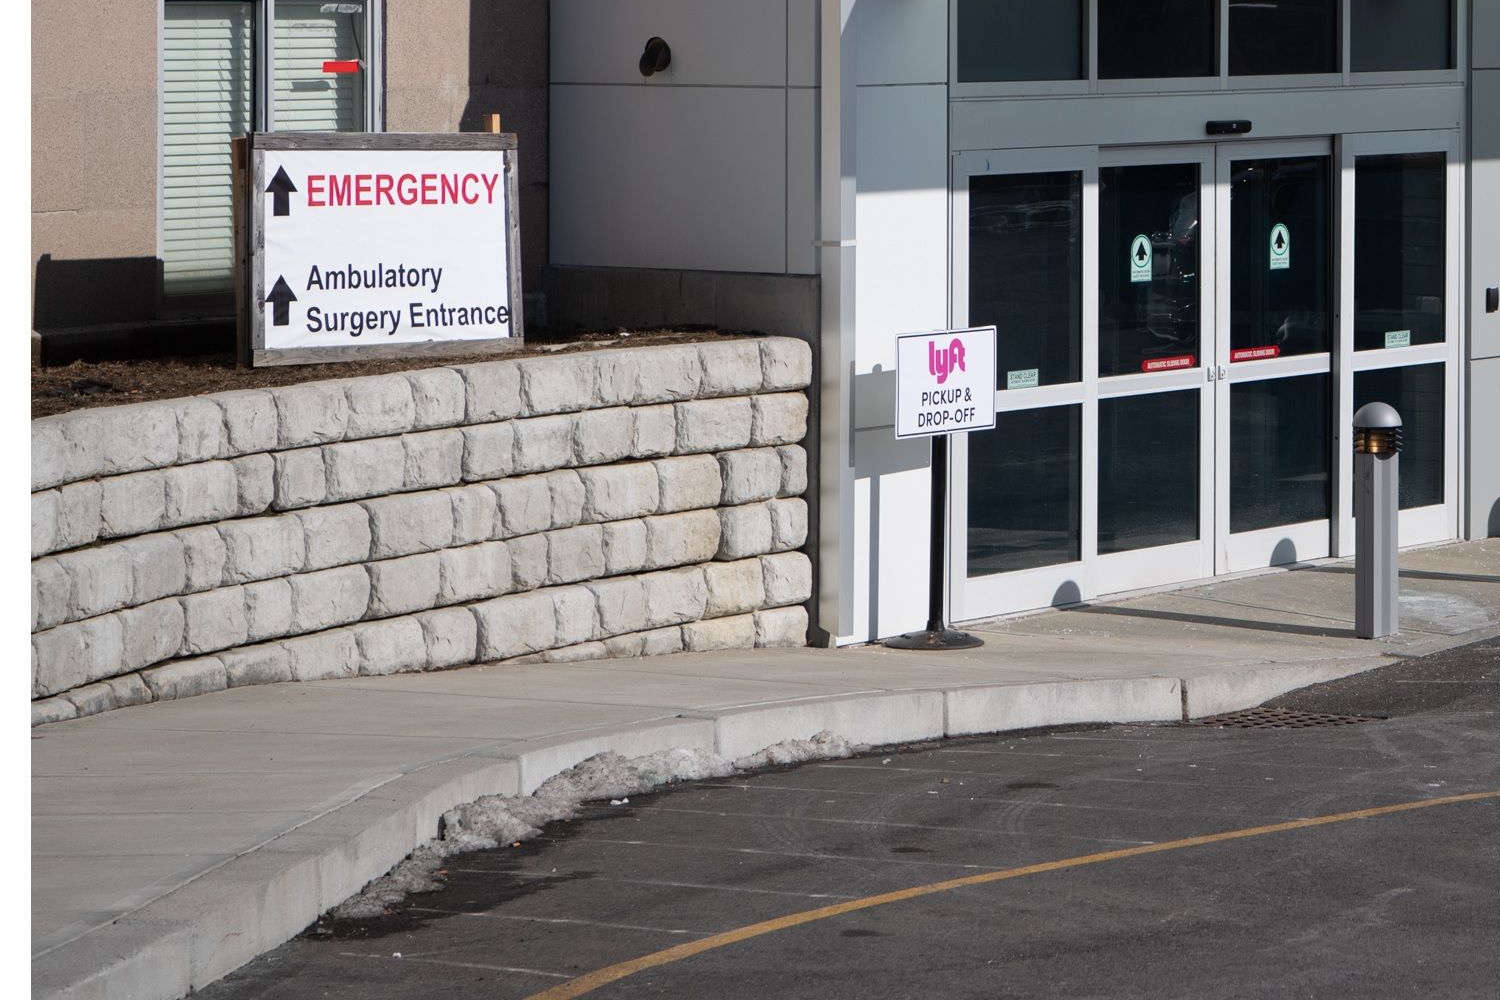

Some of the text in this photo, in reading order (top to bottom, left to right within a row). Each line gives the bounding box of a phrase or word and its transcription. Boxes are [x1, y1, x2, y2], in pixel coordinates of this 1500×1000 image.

[307, 173, 499, 207] EMERGENCY
[306, 263, 443, 293] Ambulatory
[306, 303, 509, 337] Surgery Entrance
[928, 338, 966, 385] lyft
[922, 386, 972, 407] PICKUP &
[918, 407, 976, 428] DROP-OFF
